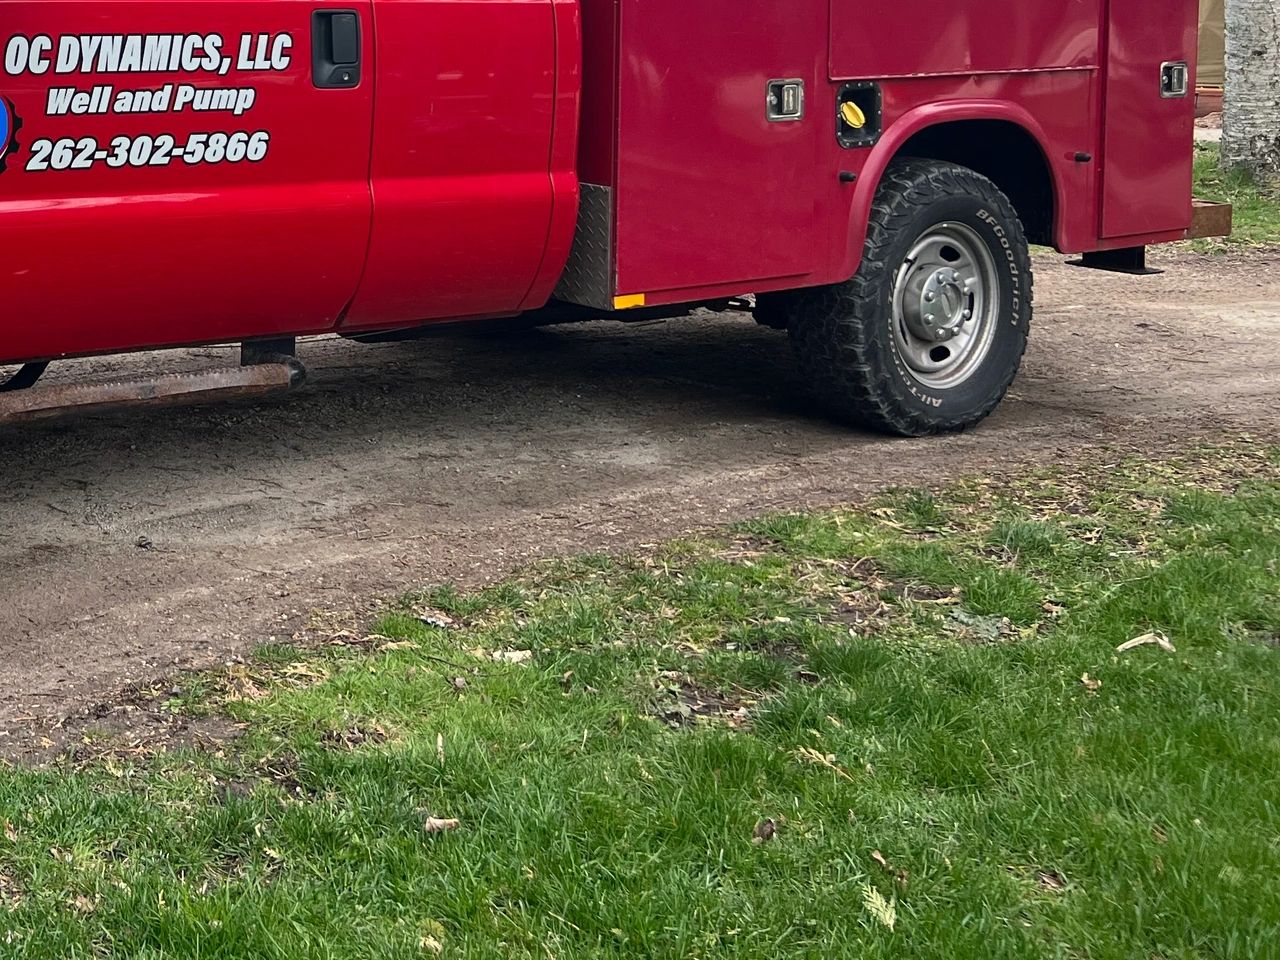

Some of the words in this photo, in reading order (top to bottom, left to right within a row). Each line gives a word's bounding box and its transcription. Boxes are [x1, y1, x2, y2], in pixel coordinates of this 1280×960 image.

[5, 35, 52, 75] OC
[55, 34, 231, 75] DYNAMICS,
[236, 33, 293, 71] LLC
[46, 86, 113, 115] Well
[113, 84, 173, 113] and
[173, 85, 256, 115] Pump
[26, 132, 269, 172] 262-302-5866
